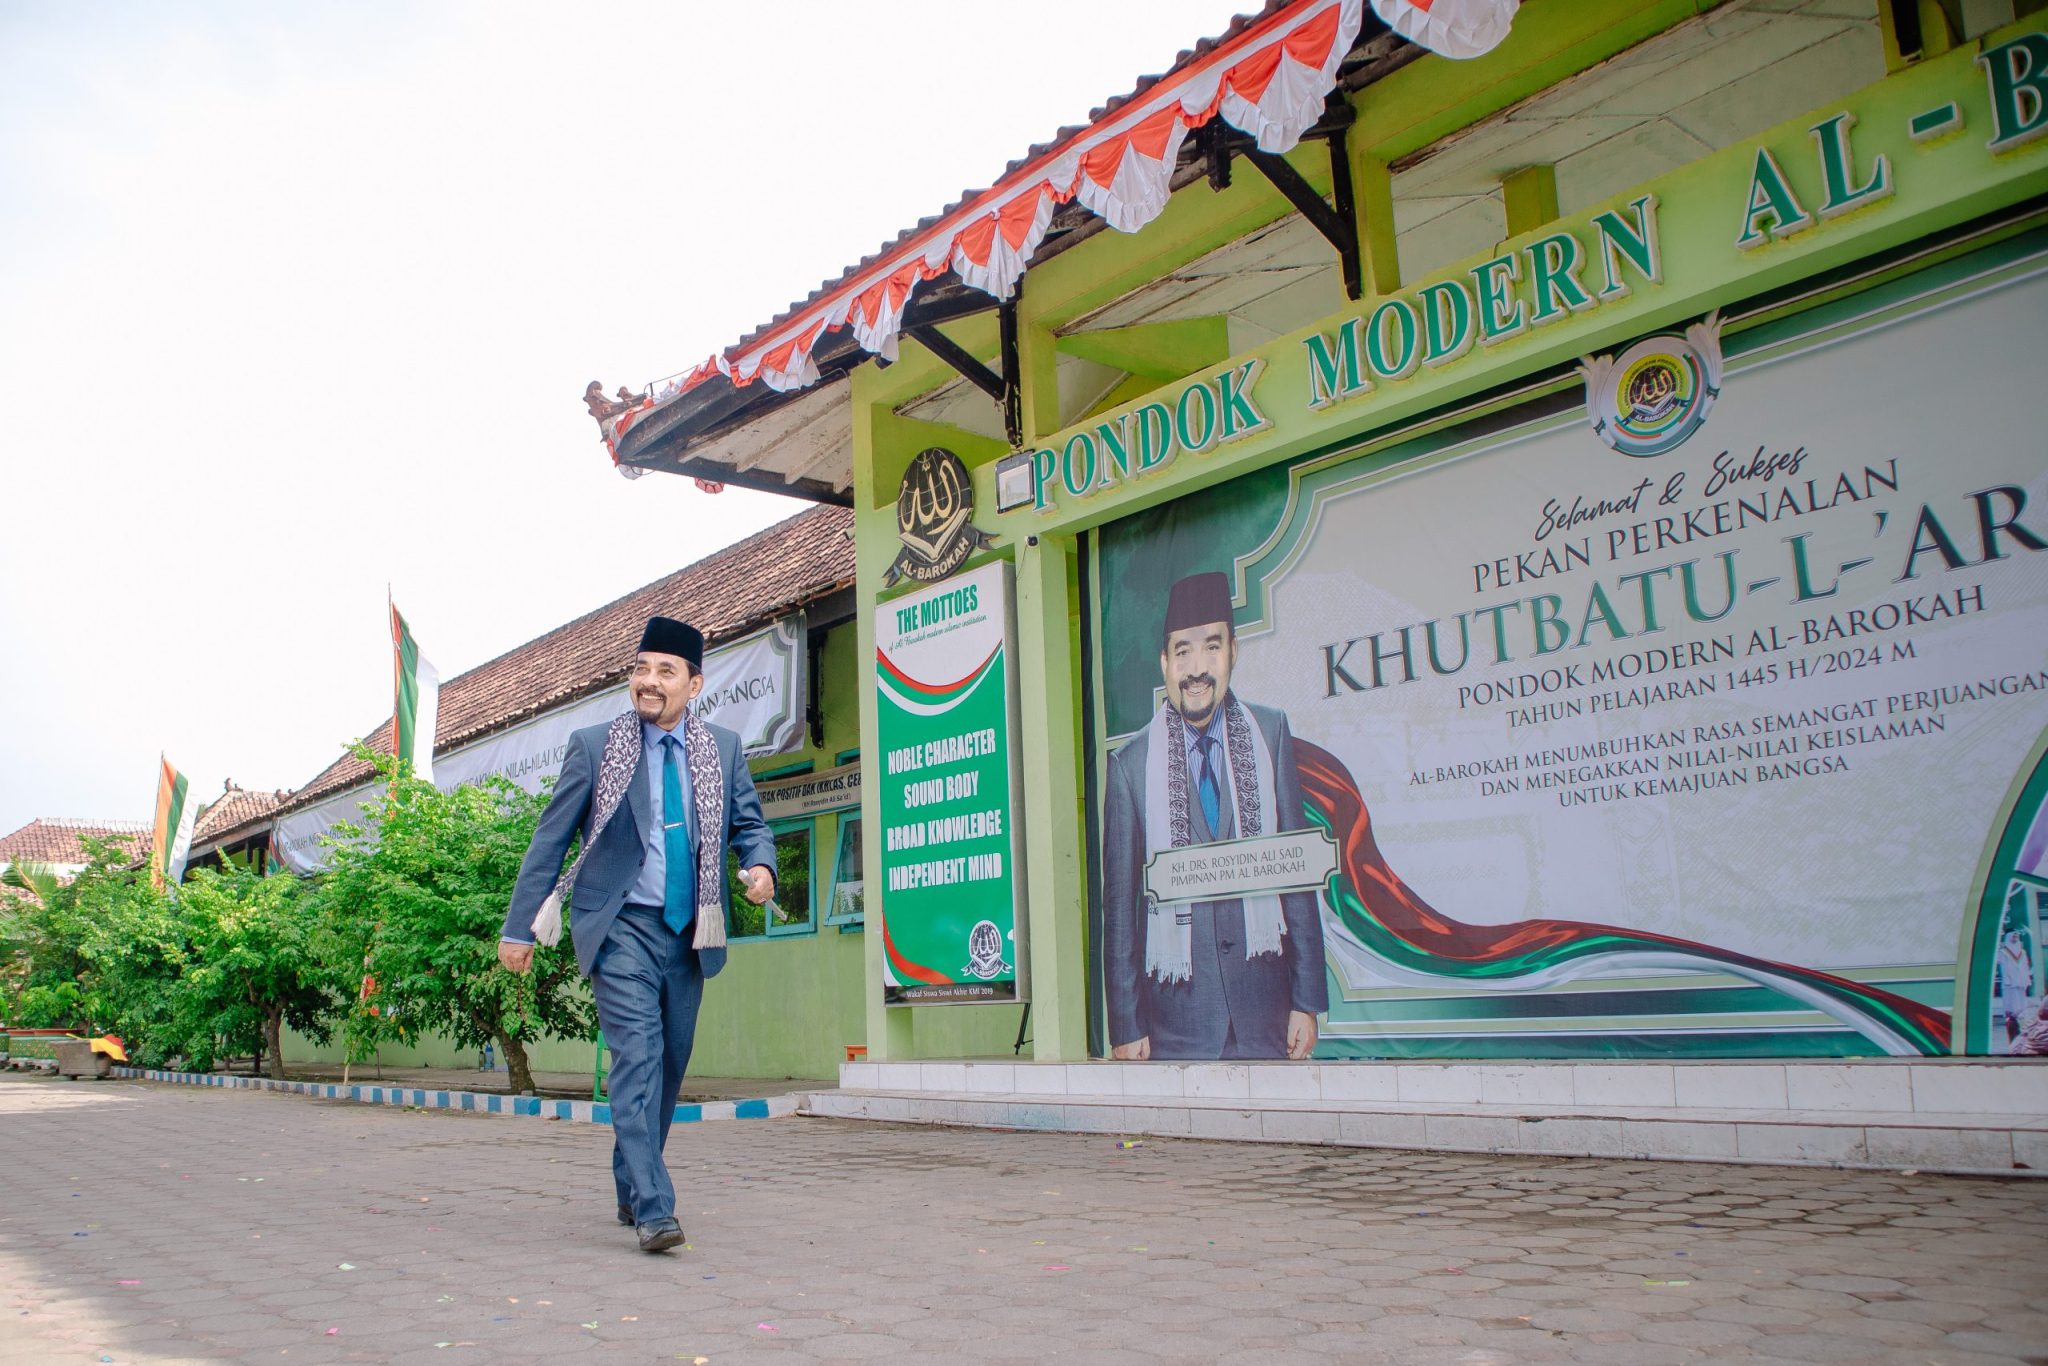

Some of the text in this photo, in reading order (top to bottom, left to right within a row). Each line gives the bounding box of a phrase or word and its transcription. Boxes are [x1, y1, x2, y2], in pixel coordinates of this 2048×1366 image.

[1031, 358, 1270, 514] PONDOK
[1302, 195, 1662, 410] MODERN
[1534, 445, 1808, 542] Selamat & Sukses
[1472, 458, 1899, 593] PEKAN PERKENALAN
[900, 537, 970, 581] AL-BAROKAH
[896, 584, 978, 635] THE MOTTOES
[1458, 584, 1987, 709] PONDOK MODERN AL-BAROKAH
[1506, 640, 1918, 728] TAHUN PELAJARAN 1445 H/2024 M
[888, 728, 996, 775] NOBLE CHARACTER
[1409, 756, 1518, 785] AL-BAROKAH
[1525, 730, 1686, 769] MENUMBUHKAN
[1693, 721, 1745, 743] RASA
[1752, 699, 1878, 735] SEMANGAT
[1481, 714, 1945, 796] DAN MENEGAKKAN NILAI-NILAI KEISLAMAN
[776, 785, 802, 802] POSITIF
[904, 770, 979, 808] SOUND BODY
[1559, 755, 1849, 808] UNTUK KEMAJUAN BANGSA
[887, 809, 1002, 852] BROAD KNOWLEDGE
[889, 853, 1002, 892] INDEPENDENT MIND
[1171, 860, 1306, 887] PIMPINAN PM AL BAROKAH
[1172, 846, 1303, 874] KH. DRS. ROSYIDIN ALI SAID
[981, 987, 994, 995] 2019
